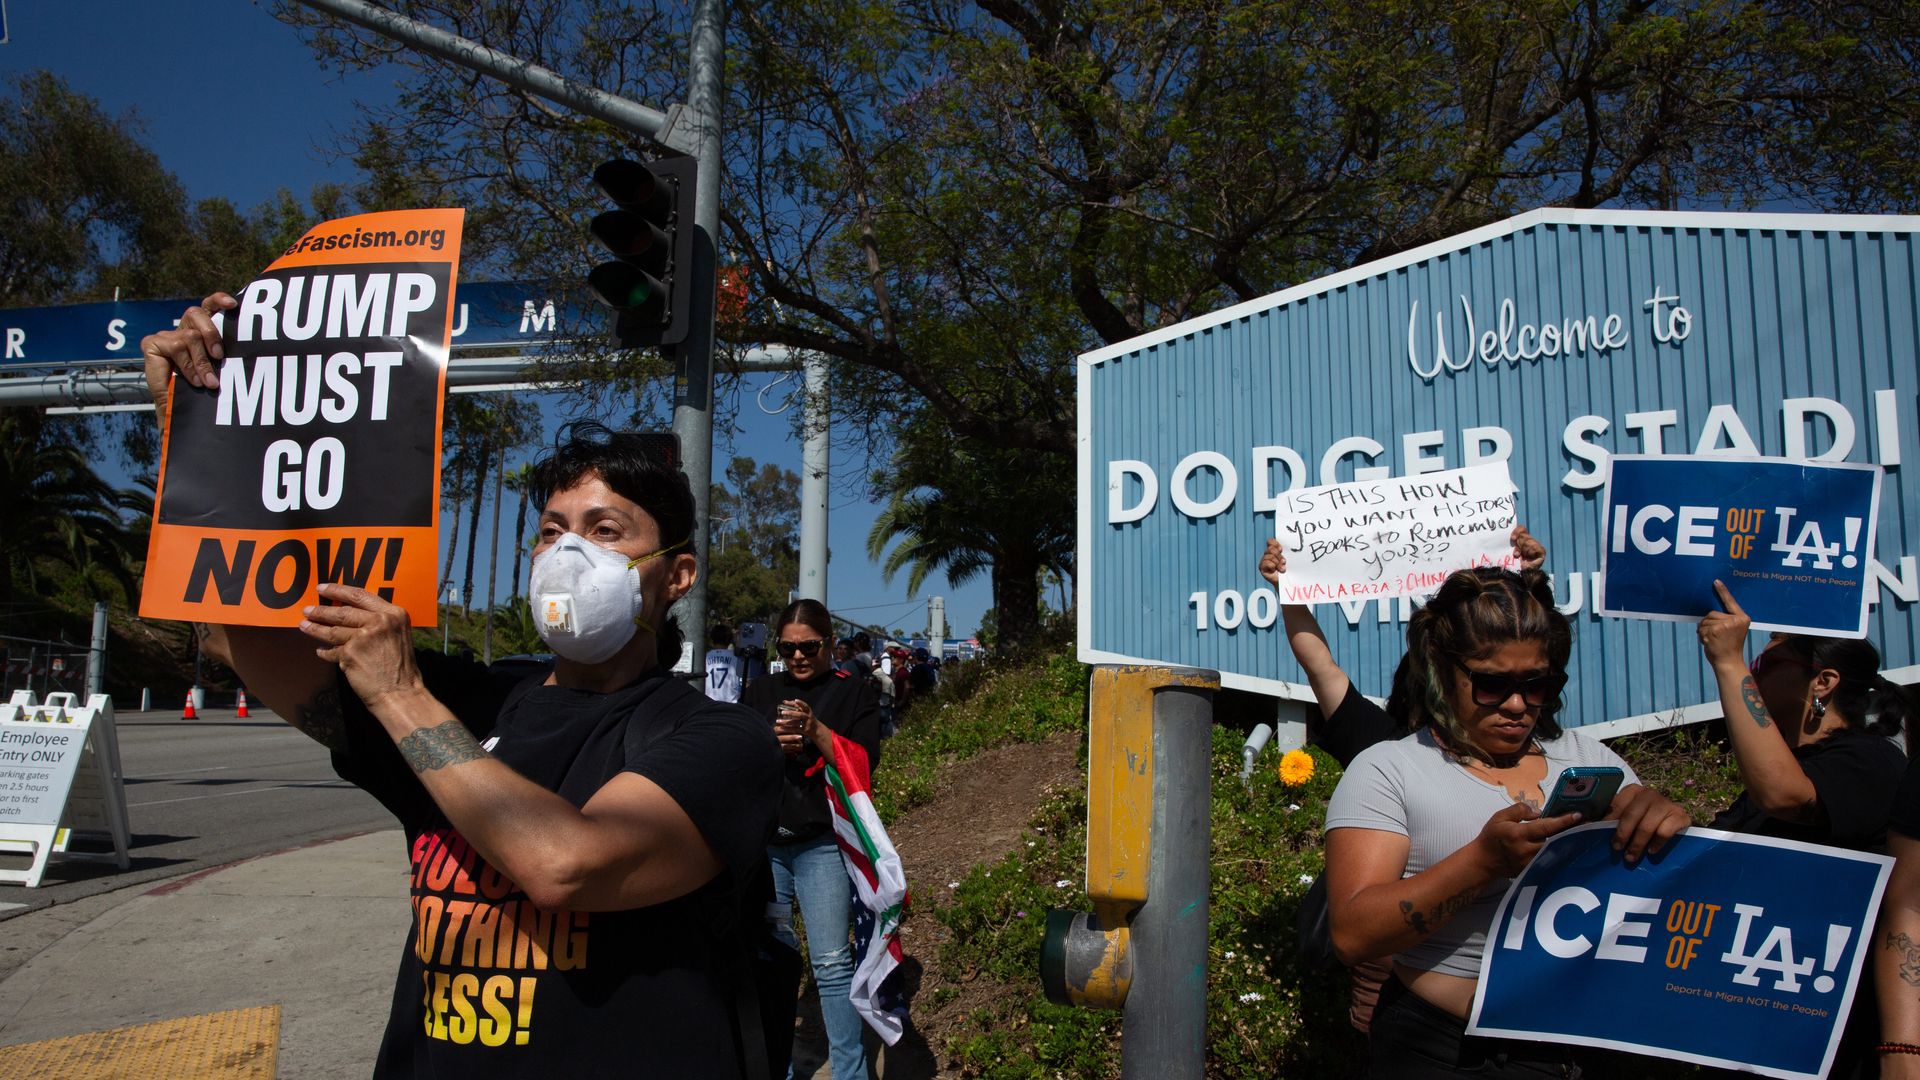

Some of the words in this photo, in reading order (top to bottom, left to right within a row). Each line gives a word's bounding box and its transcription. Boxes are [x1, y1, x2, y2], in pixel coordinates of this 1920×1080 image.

[212, 273, 437, 342] RUMP
[1408, 294, 1628, 378] Welcome
[1644, 286, 1692, 342] to
[215, 351, 403, 426] MUST
[261, 436, 346, 512] GO
[1108, 426, 1520, 524] DODGER
[1287, 493, 1315, 514] IS
[1318, 485, 1385, 510] THIS
[1344, 507, 1417, 527] WANT
[1612, 504, 1719, 557] ICE
[1725, 507, 1766, 534] OUT
[1729, 534, 1756, 560] OF
[183, 537, 404, 609] NOW!
[1829, 578, 1857, 587] People
[710, 668, 728, 688] 17
[1, 731, 69, 747] Employee
[31, 751, 65, 762] ONLY
[10, 782, 24, 791] 2.5
[25, 783, 49, 792] hours
[26, 772, 49, 781] gates
[11, 795, 20, 803] to
[22, 794, 40, 804] first
[411, 896, 589, 971] OTHING
[1503, 884, 1662, 963] ICE
[1667, 899, 1721, 938] OUT
[1665, 935, 1703, 971] OF
[1665, 983, 1702, 995] Deport
[1704, 990, 1713, 998] la
[1715, 991, 1744, 1003] Migra
[1746, 997, 1770, 1007] NOT
[1772, 1000, 1789, 1011] the
[1792, 1004, 1828, 1017] People
